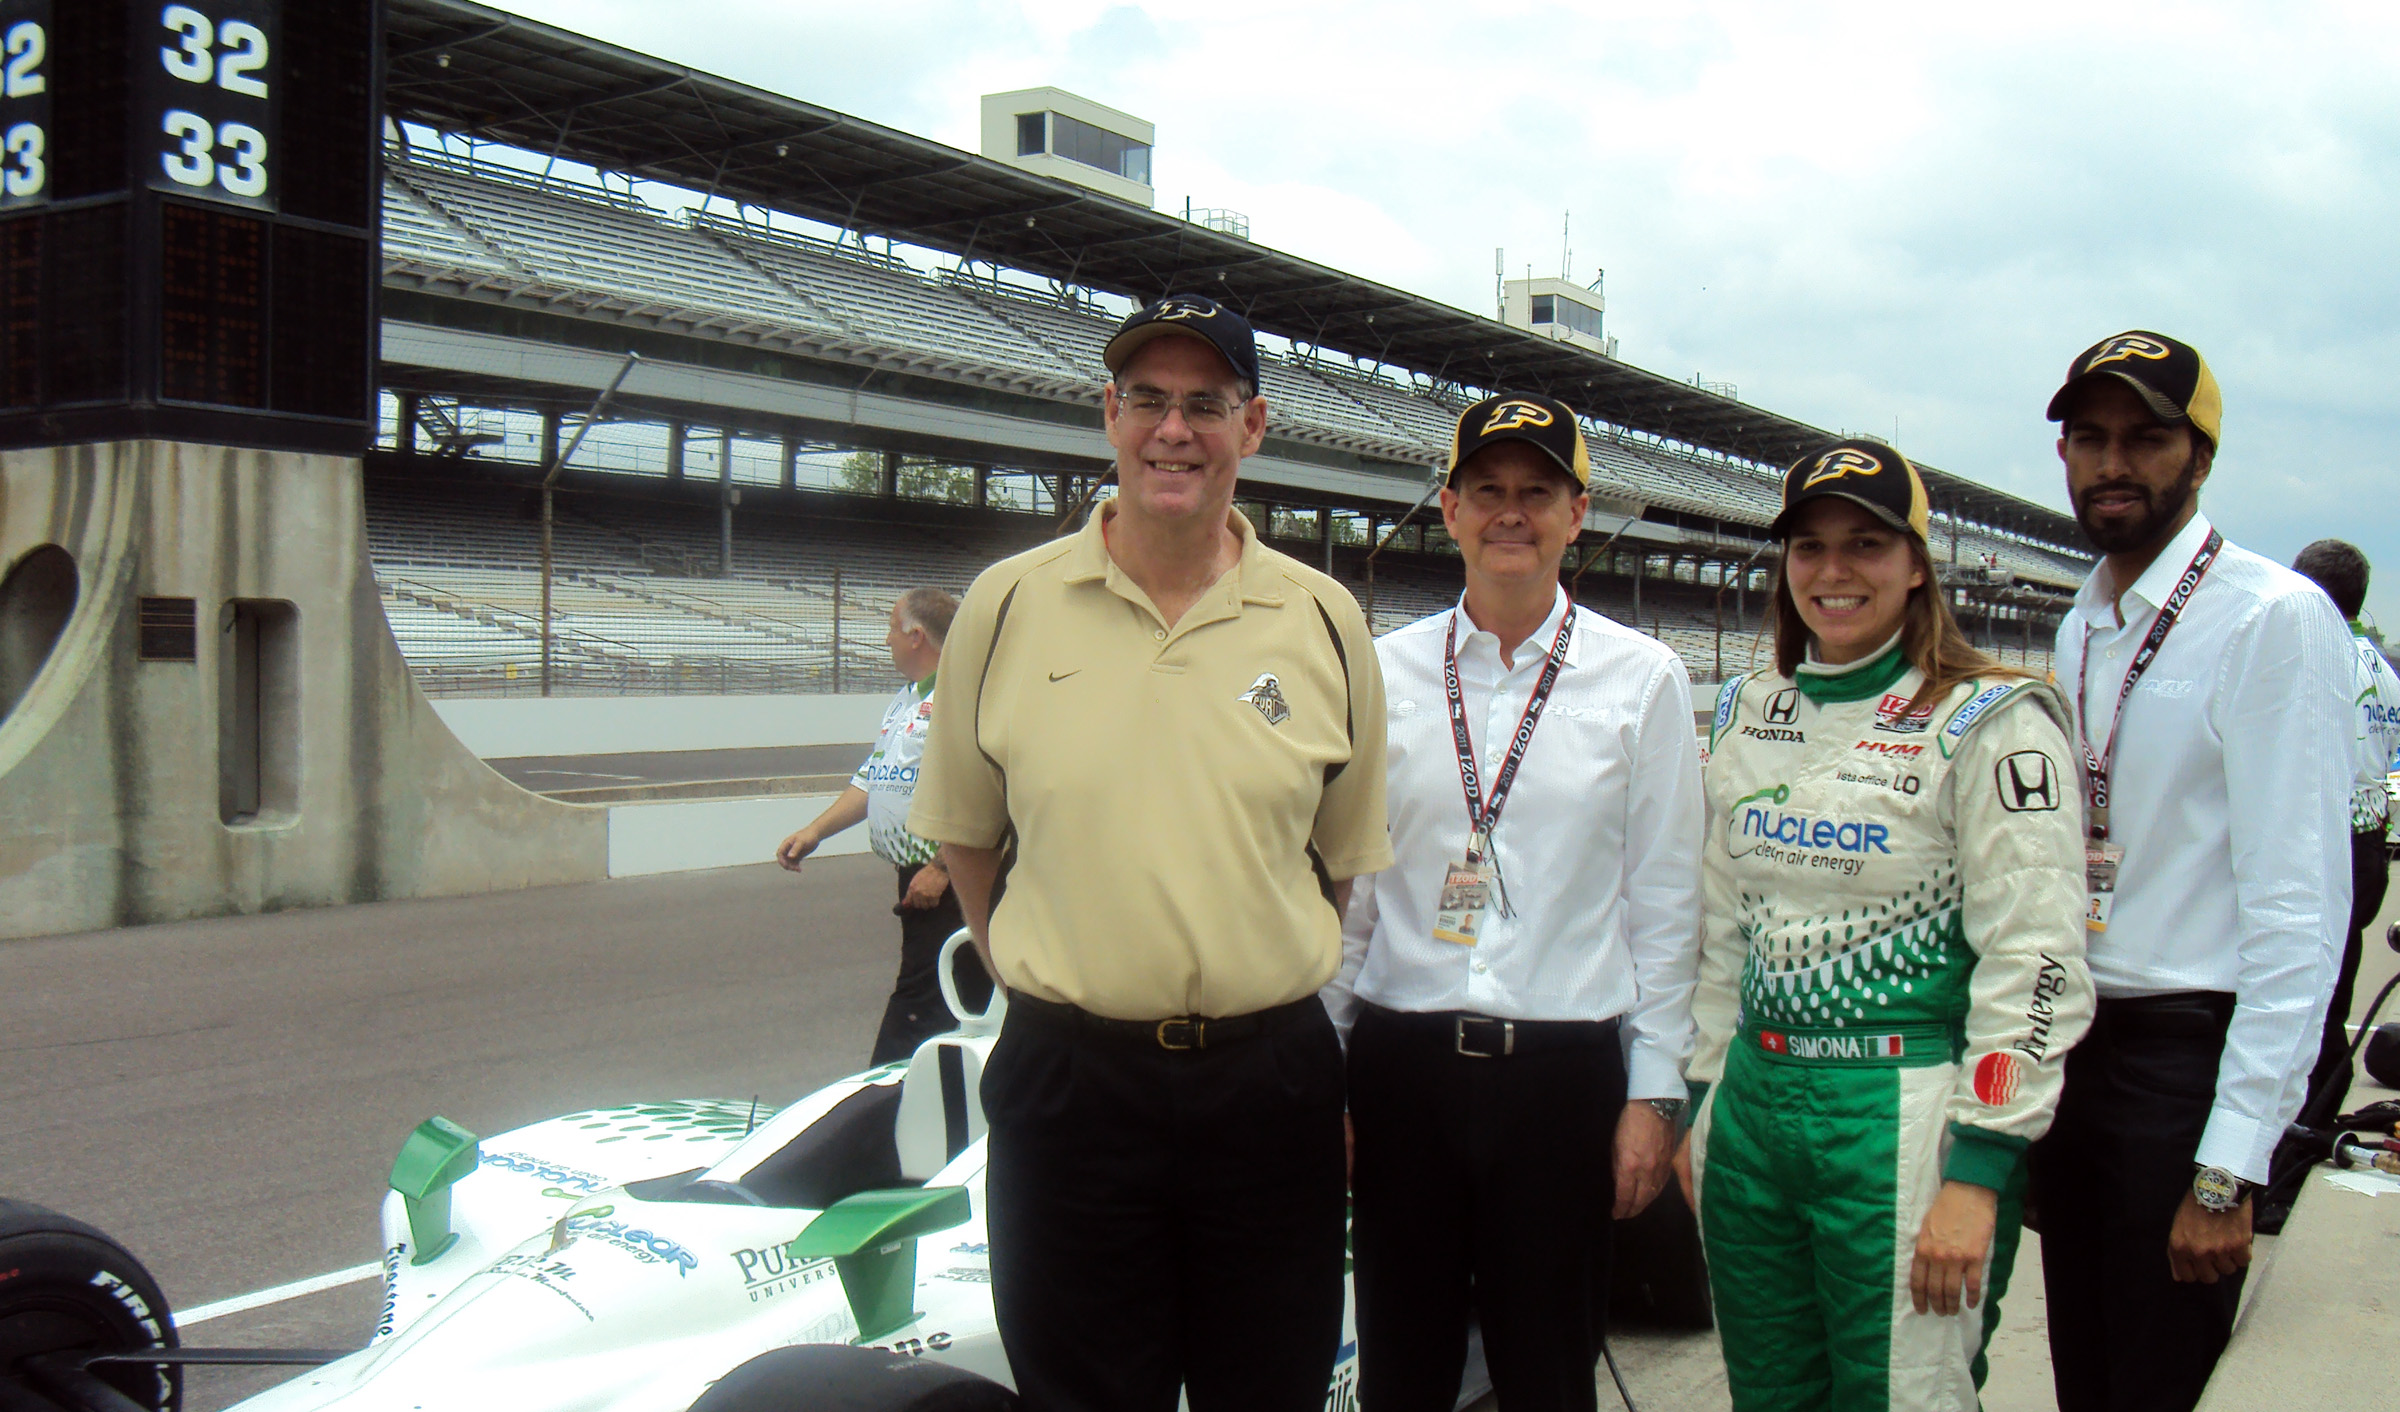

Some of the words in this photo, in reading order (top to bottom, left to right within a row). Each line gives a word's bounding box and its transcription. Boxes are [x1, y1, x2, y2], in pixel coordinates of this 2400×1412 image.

[0, 21, 46, 99] 2
[161, 4, 269, 99] 32
[0, 122, 45, 197] 3
[161, 109, 268, 198] 33
[2165, 570, 2199, 616] IZOD
[2150, 616, 2171, 644] 2011
[1549, 629, 1569, 670] IZOD
[1445, 659, 1460, 699] IZOD
[1539, 669, 1555, 694] 2011
[1882, 696, 1934, 717] IZD
[1950, 685, 2008, 732] sparco
[1455, 726, 1468, 749] 2011
[1510, 717, 1535, 763] IZOD
[1740, 726, 1806, 744] HONDA
[1854, 740, 1925, 756] HVM
[1459, 754, 1480, 799] IZOD
[1500, 762, 1516, 788] 2011
[1858, 775, 1888, 787] office
[1755, 840, 1784, 862] clean
[1787, 849, 1809, 866] air
[1811, 853, 1865, 876] energy
[2014, 952, 2067, 1065] Entergy
[1788, 1035, 1861, 1058] SIMONA
[608, 1239, 661, 1264] energy
